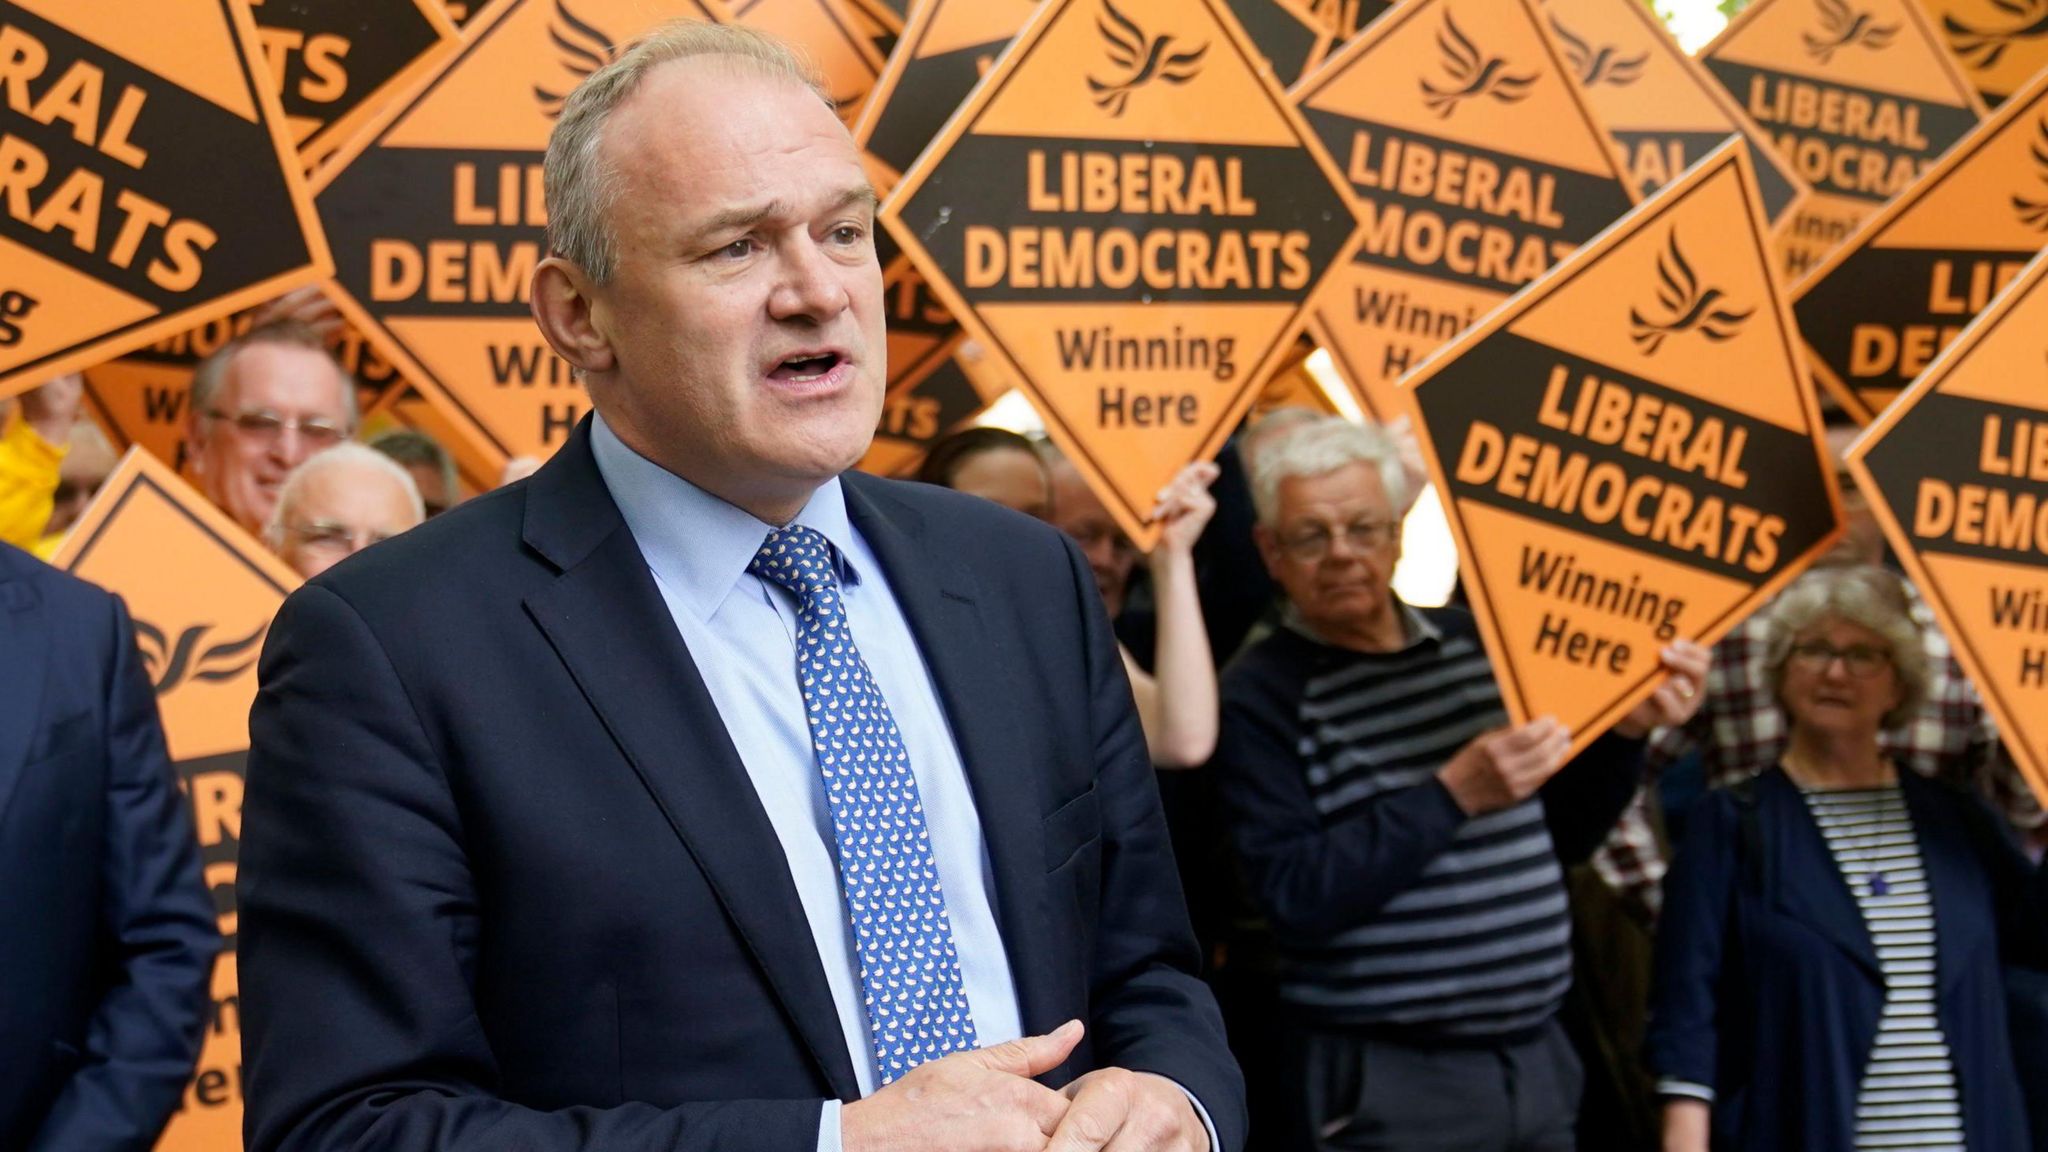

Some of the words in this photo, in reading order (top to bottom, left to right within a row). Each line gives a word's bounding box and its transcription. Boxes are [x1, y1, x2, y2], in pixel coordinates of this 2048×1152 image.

[1751, 74, 1929, 151] LIBERAL
[1027, 150, 1257, 216] LIBERAL
[1350, 130, 1565, 229] LIBERAL
[1764, 128, 1936, 196] OCRA
[0, 133, 218, 292] RATS
[963, 226, 1312, 290] DEMOCRATS
[1056, 327, 1236, 381] Winning
[1099, 388, 1198, 428] Here
[1537, 364, 1748, 489] LIBERAL
[1455, 420, 1786, 574] DEMOCRATS
[1518, 546, 1686, 641] Winning
[1533, 613, 1633, 674] Here
